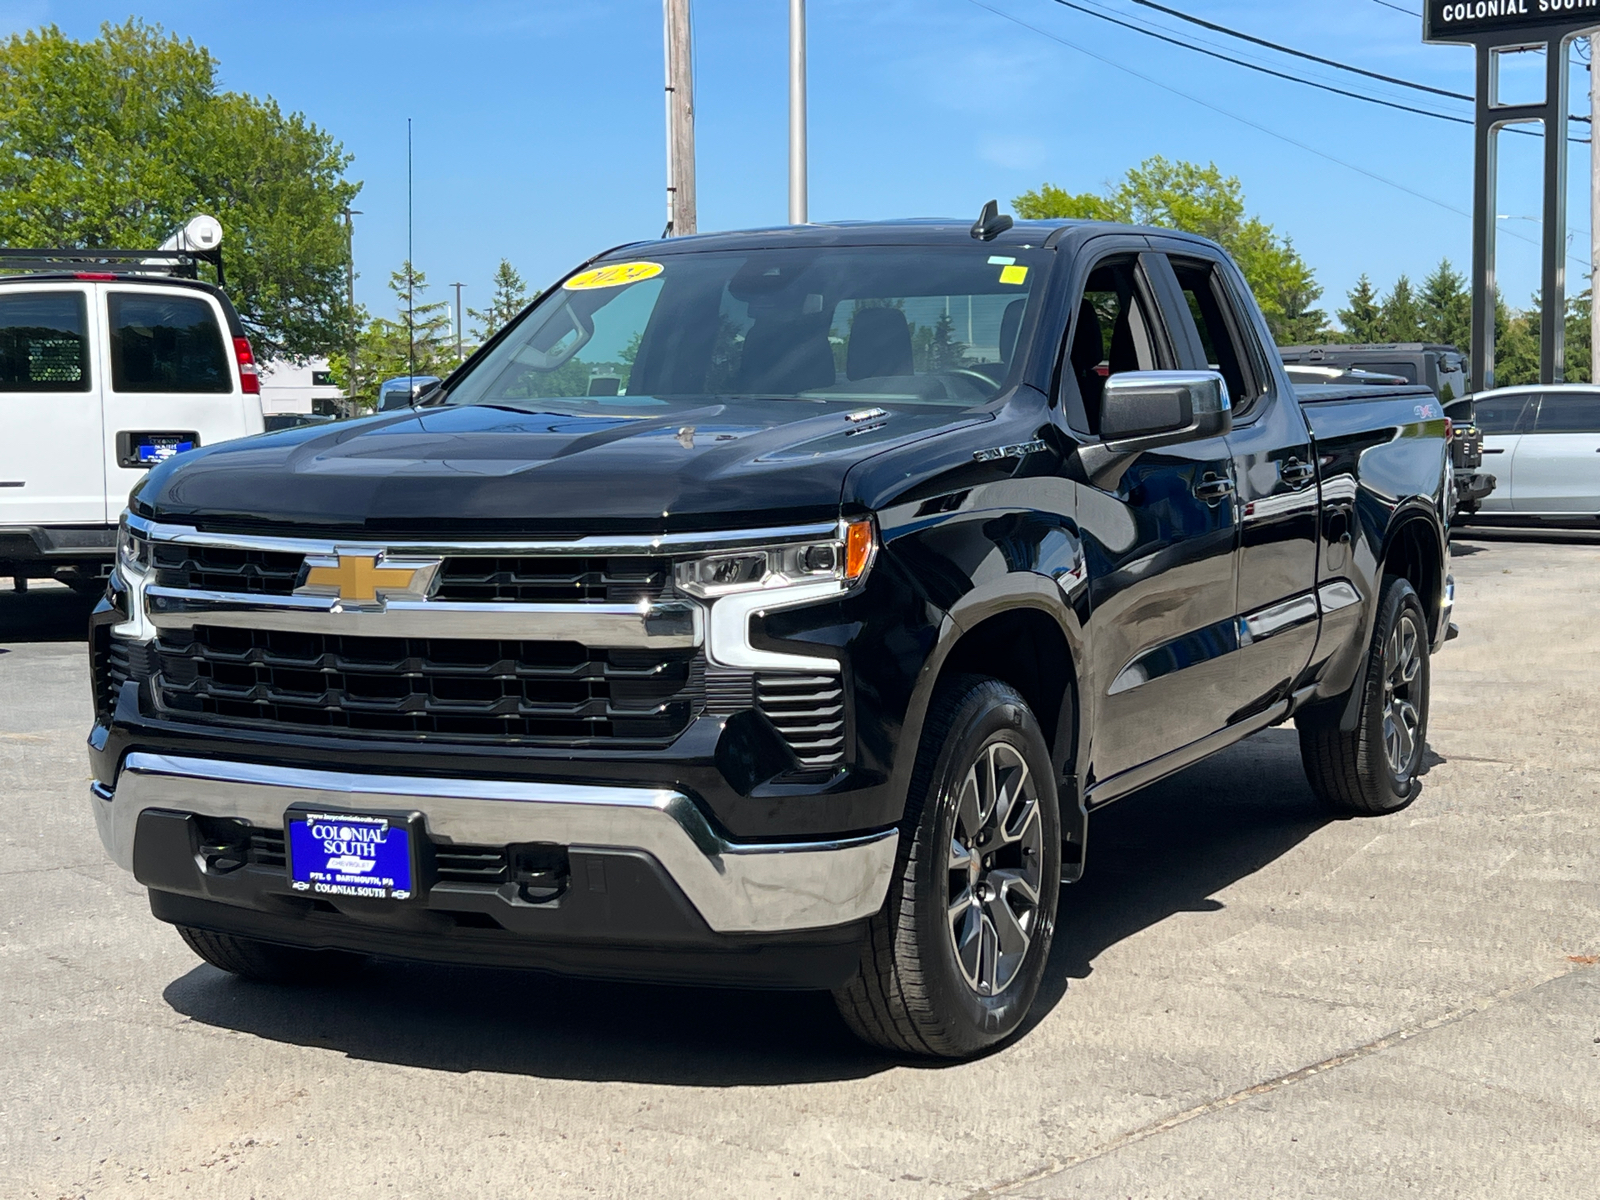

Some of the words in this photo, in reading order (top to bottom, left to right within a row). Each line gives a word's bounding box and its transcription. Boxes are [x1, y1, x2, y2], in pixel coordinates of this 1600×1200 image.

[1442, 0, 1528, 21] COLONIAL
[312, 825, 387, 844] COLONIAL
[323, 840, 376, 857] SOUTH
[331, 859, 371, 868] CHEVROLET
